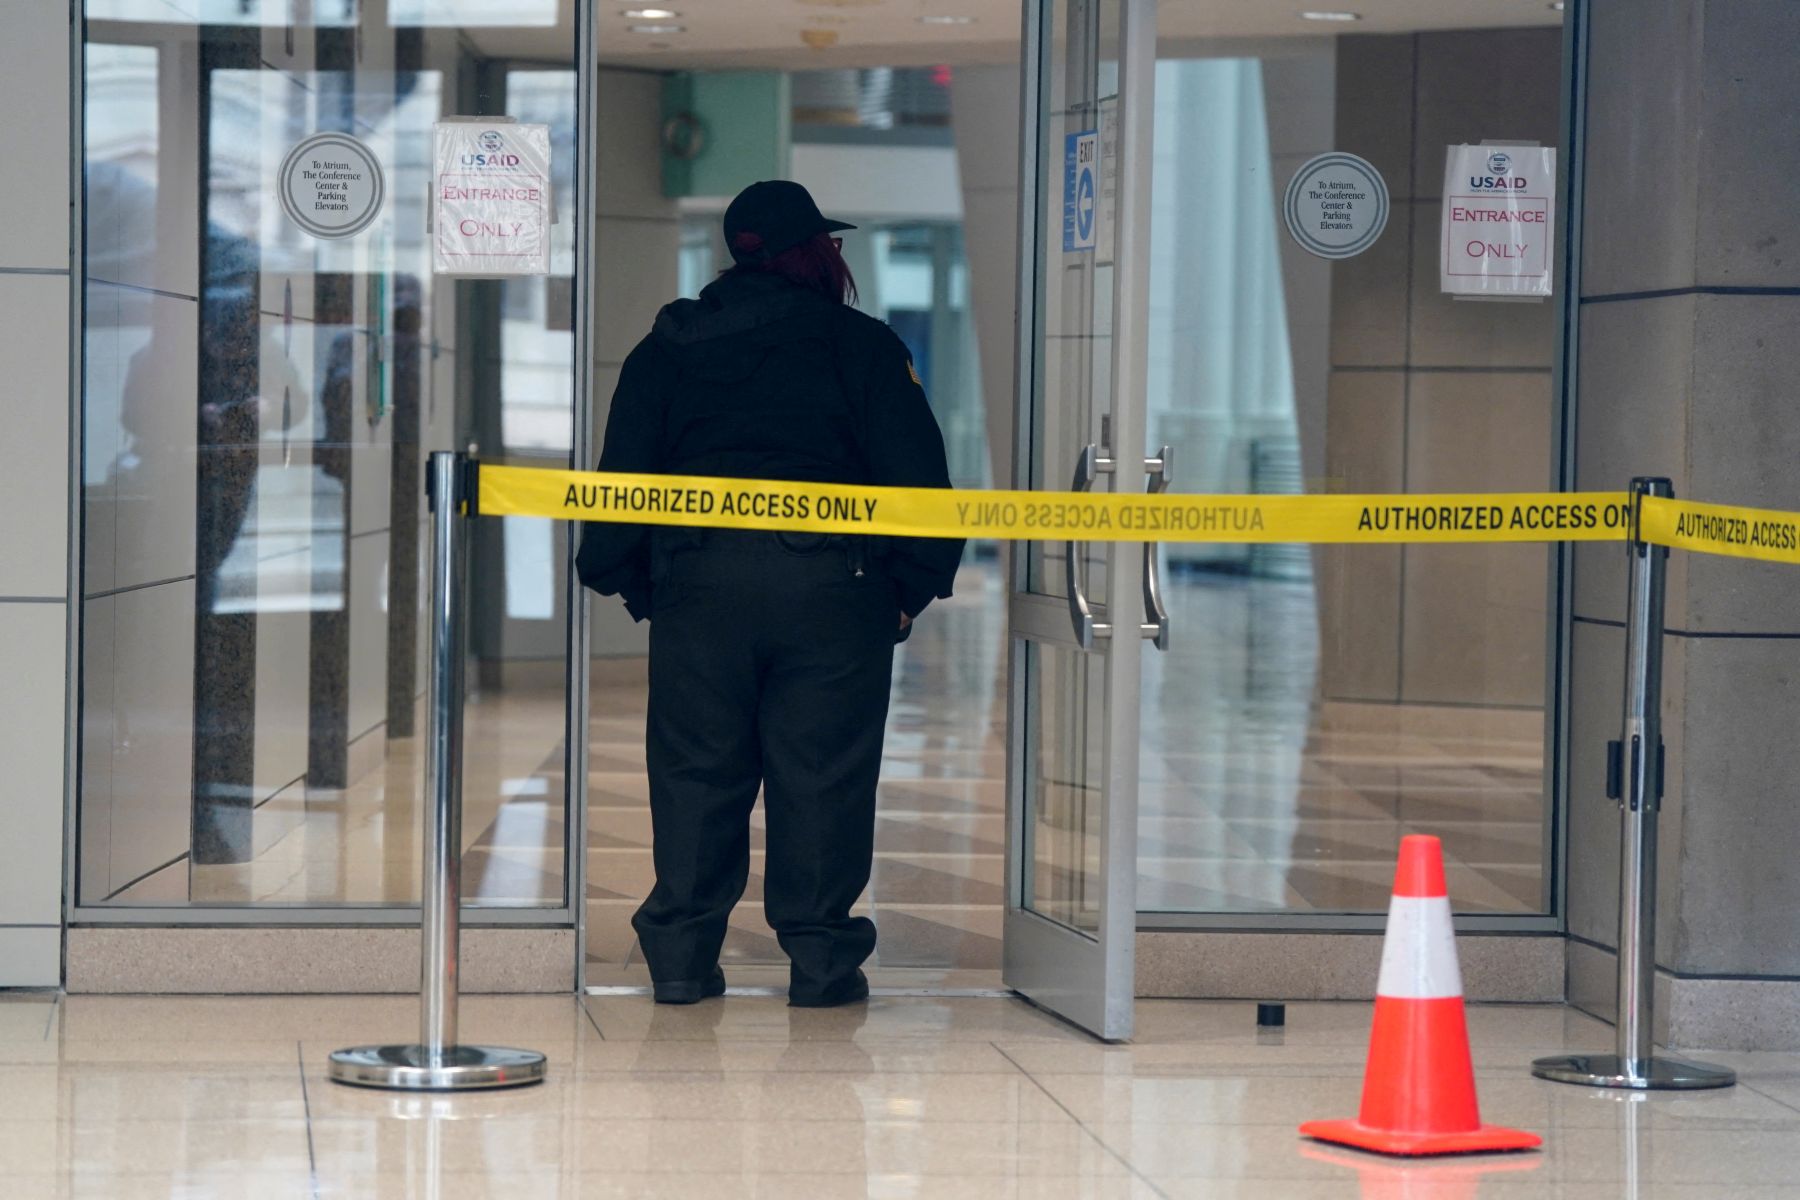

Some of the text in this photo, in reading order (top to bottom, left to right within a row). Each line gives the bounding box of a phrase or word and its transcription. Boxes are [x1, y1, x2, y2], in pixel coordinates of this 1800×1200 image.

[1080, 141, 1094, 163] EXIT
[312, 160, 351, 171] To Atrium,
[461, 154, 520, 167] USAID
[302, 170, 361, 181] The Conference
[315, 181, 349, 190] Center &
[1318, 180, 1356, 191] To Atrium,
[1470, 176, 1527, 189] USAID
[317, 191, 347, 203] Parking
[443, 185, 539, 201] ENTRANCE
[1308, 190, 1366, 200] The Conference
[315, 201, 349, 211] Elevators
[1320, 201, 1353, 210] Center &
[1323, 211, 1351, 222] Parking
[1452, 207, 1545, 223] ENTRANCE
[459, 219, 523, 237] ONLY
[1320, 221, 1353, 230] Elevators
[1466, 240, 1529, 258] ONLY
[564, 484, 878, 522] AUTHORIZED ACCESS ONLY
[1358, 504, 1632, 531] AUTHORIZED ACCESS ON
[1675, 512, 1748, 545] AUTHORIZED
[1750, 521, 1796, 550] ACCESS
